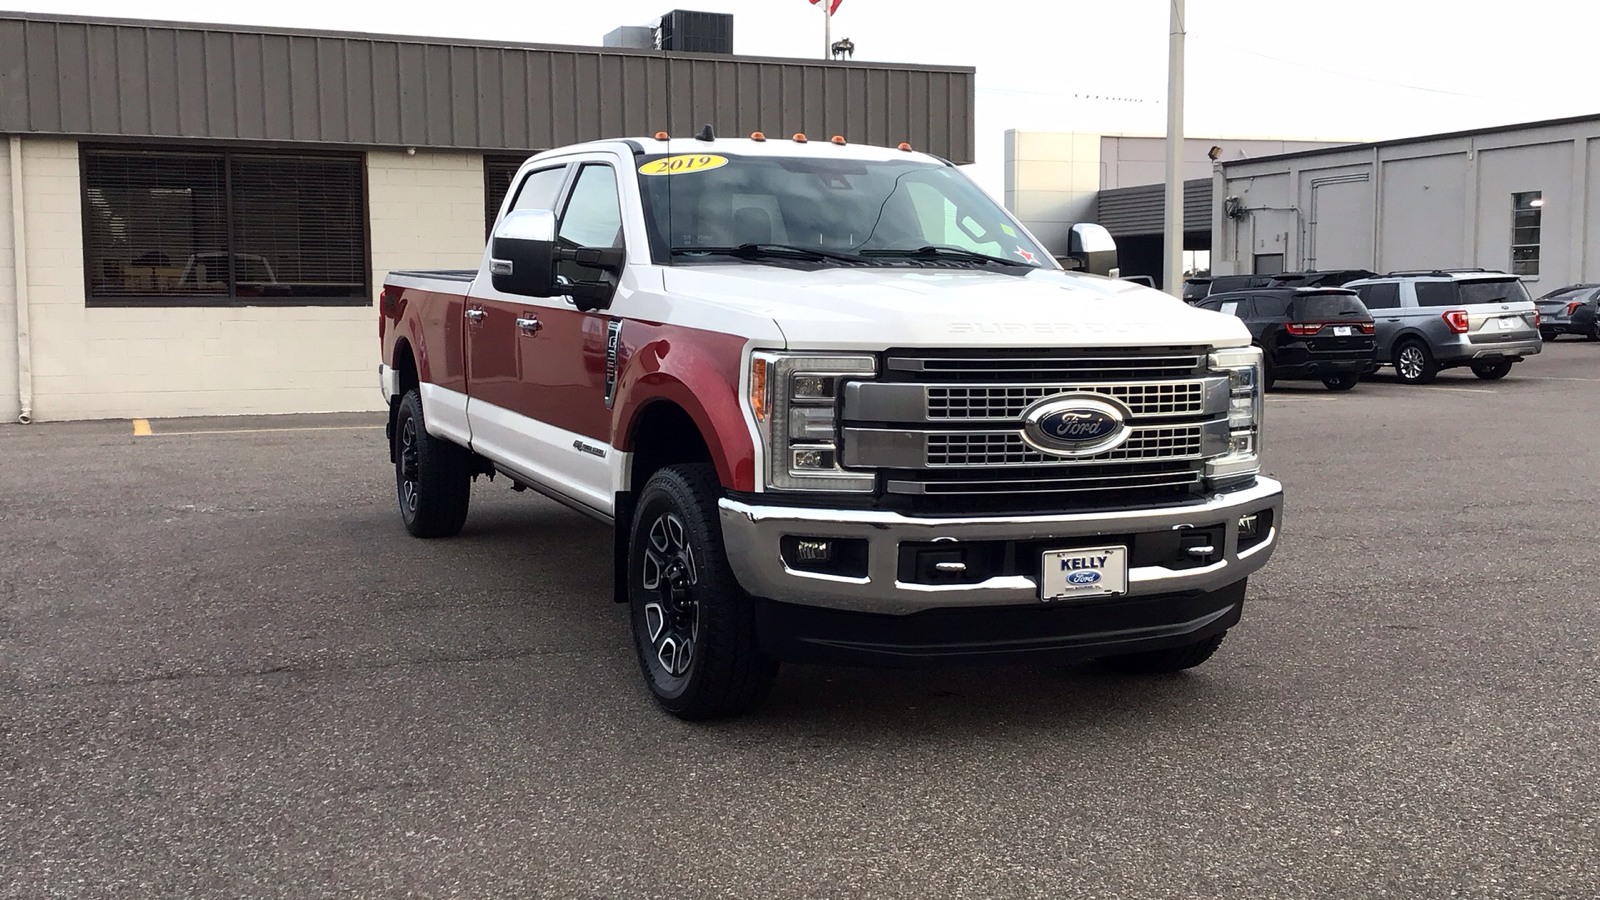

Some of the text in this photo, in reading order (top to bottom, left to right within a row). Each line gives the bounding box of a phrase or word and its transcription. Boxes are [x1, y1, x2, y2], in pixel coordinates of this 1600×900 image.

[655, 156, 711, 173] 2019
[947, 322, 1080, 334] SUPER
[1056, 412, 1103, 435] Ford
[1061, 556, 1107, 571] KELLY
[1073, 572, 1095, 583] Ford
